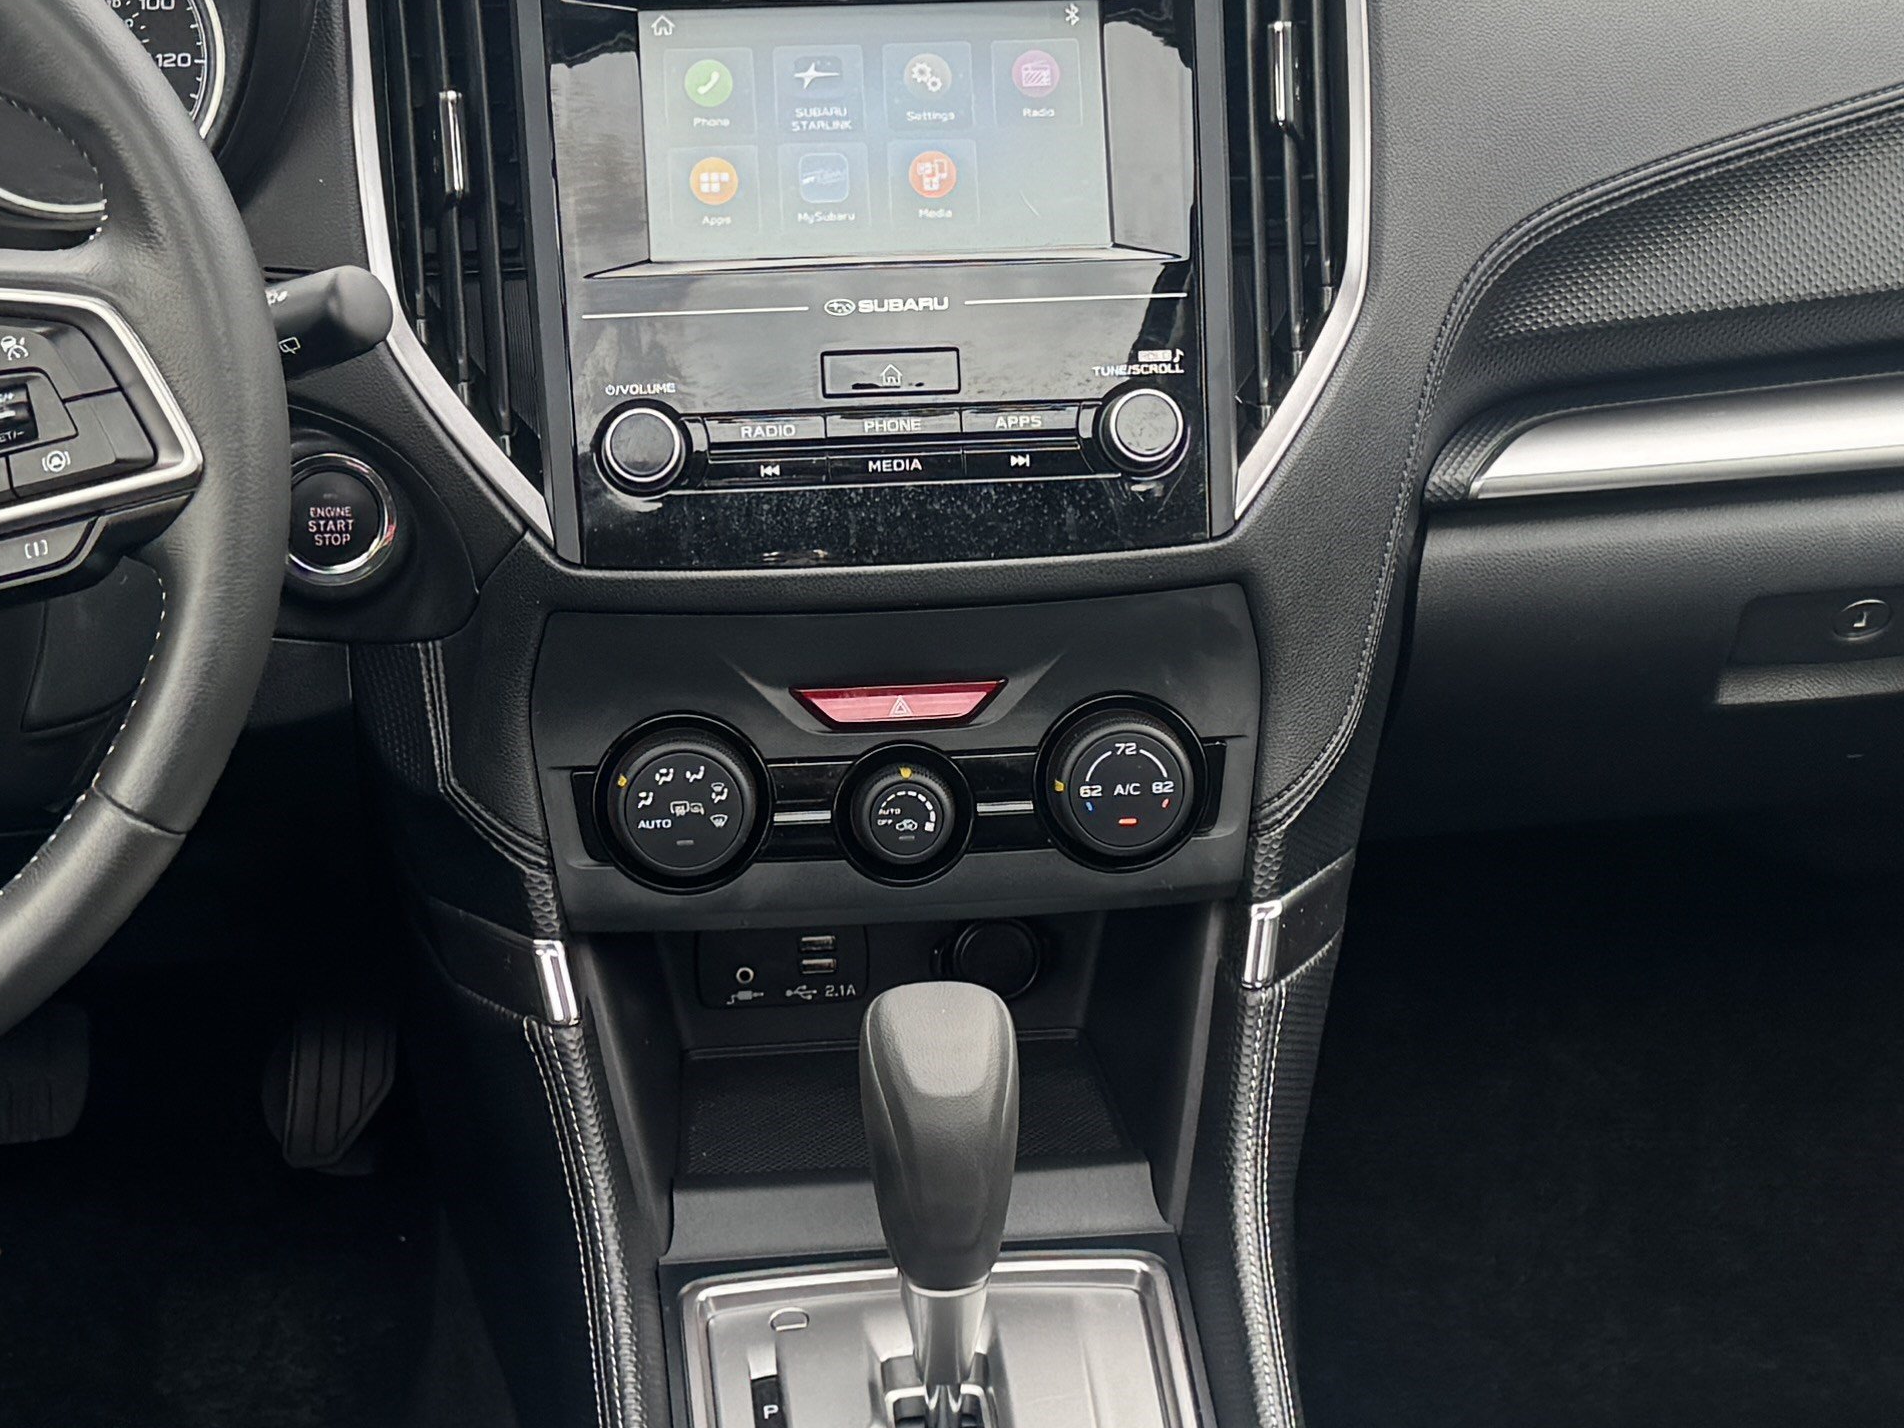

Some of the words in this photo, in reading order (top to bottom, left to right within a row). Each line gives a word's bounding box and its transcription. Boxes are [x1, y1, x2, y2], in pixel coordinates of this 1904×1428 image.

[155, 52, 193, 69] 120
[794, 106, 848, 119] SUBARU
[693, 116, 731, 128] Phone
[791, 120, 854, 132] STARLINK
[701, 215, 733, 227] Apps
[857, 296, 950, 314] SUBARU
[864, 418, 923, 434] PHONE
[995, 414, 1043, 431] APPS
[740, 423, 796, 440] RADIO
[867, 458, 923, 473] MEDIA
[309, 505, 353, 518] ENGINE
[307, 518, 355, 533] START
[314, 532, 351, 547] STOP
[1114, 742, 1137, 756] 72
[1079, 784, 1103, 798] 62
[1113, 782, 1142, 796] A/C
[1152, 780, 1175, 794] 82
[637, 818, 672, 830] AUTO
[824, 983, 857, 998] 2.1A
[762, 1404, 779, 1420] P
